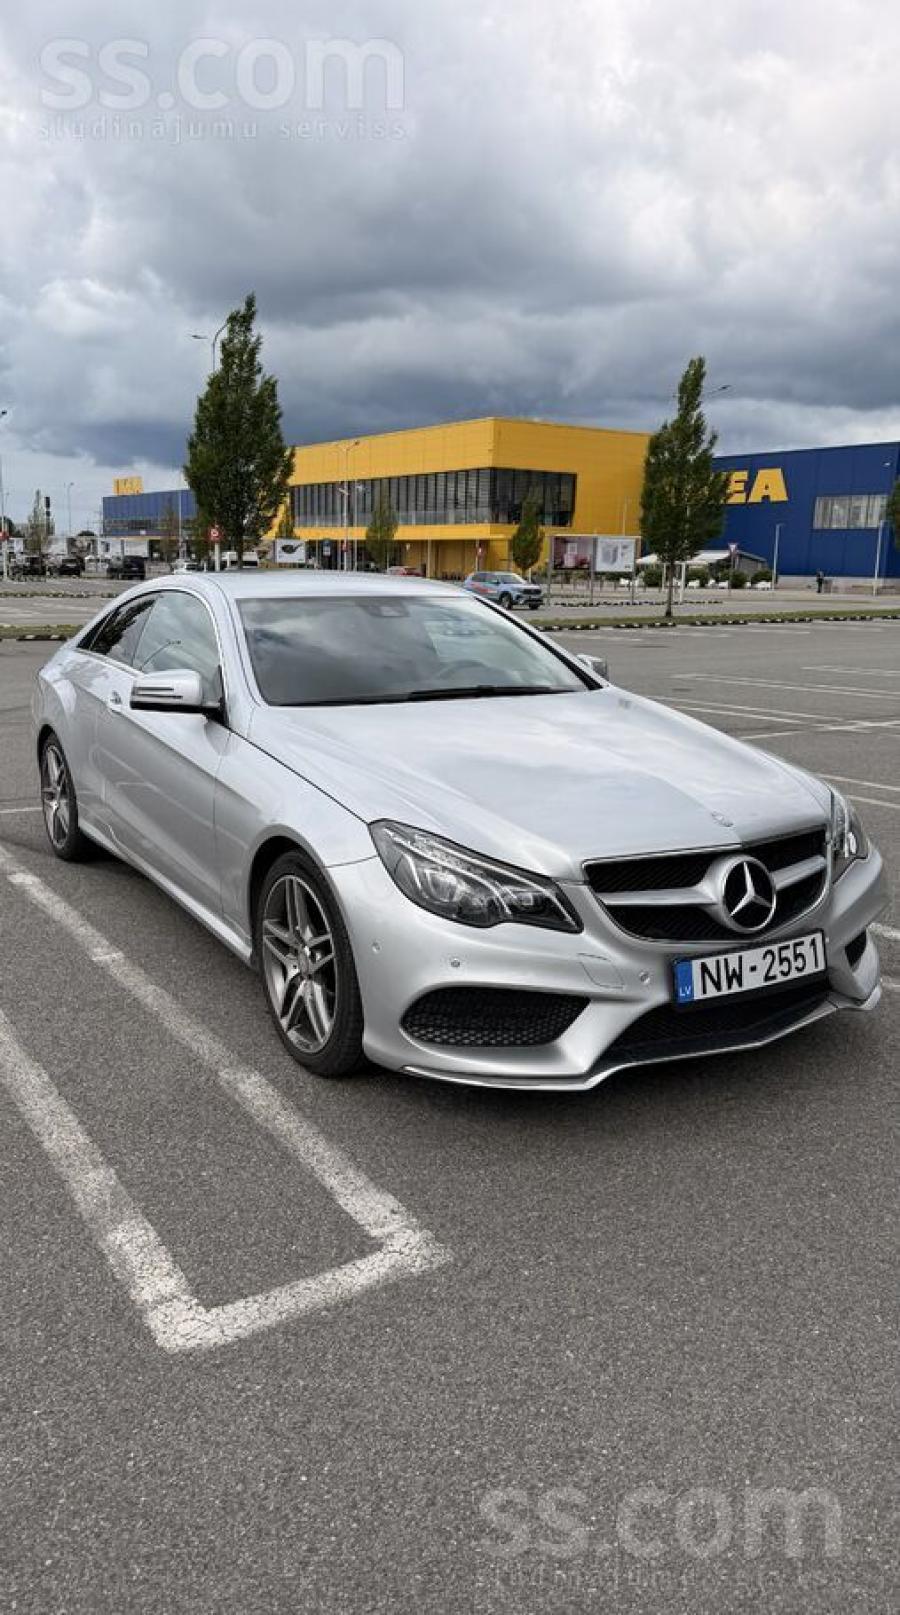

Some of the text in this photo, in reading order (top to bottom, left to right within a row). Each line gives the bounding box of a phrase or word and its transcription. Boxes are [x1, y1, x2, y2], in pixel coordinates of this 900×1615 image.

[724, 468, 788, 504] EA
[701, 937, 819, 995] NW-2551
[679, 985, 692, 997] LV
